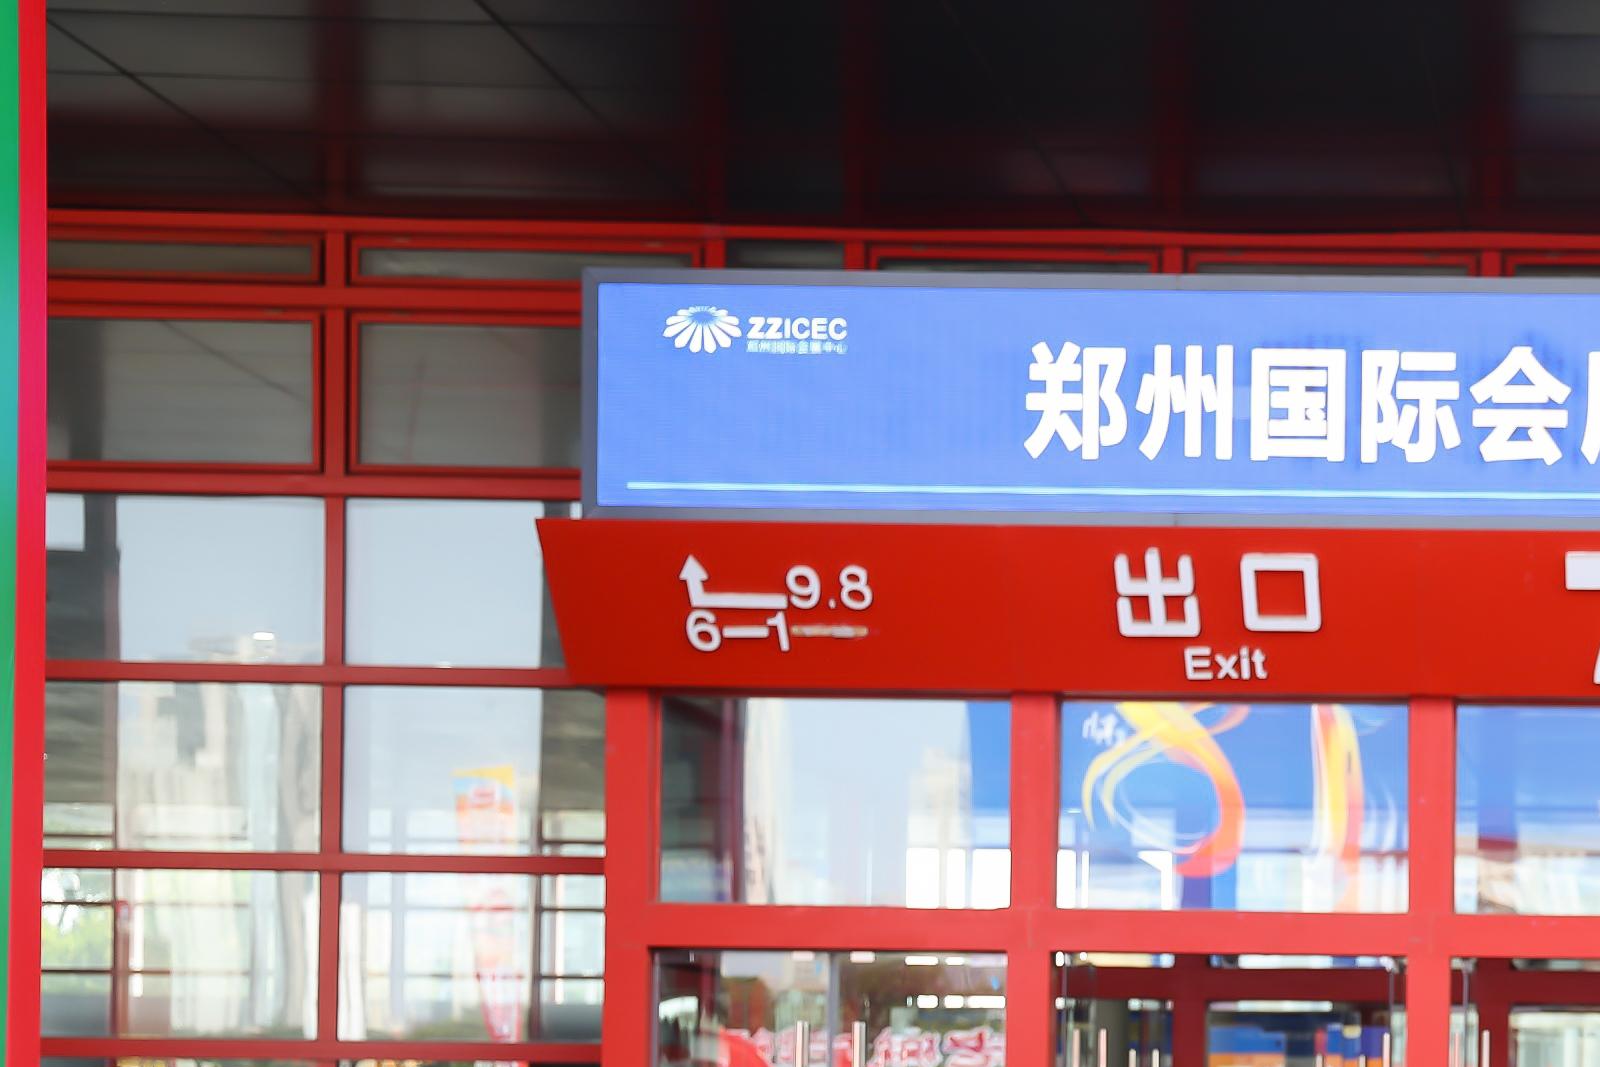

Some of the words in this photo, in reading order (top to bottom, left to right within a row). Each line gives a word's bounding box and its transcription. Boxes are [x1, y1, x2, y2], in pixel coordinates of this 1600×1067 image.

[746, 316, 848, 341] ZZICEC
[1113, 546, 1323, 639] 出口
[1184, 646, 1268, 682] Exit
